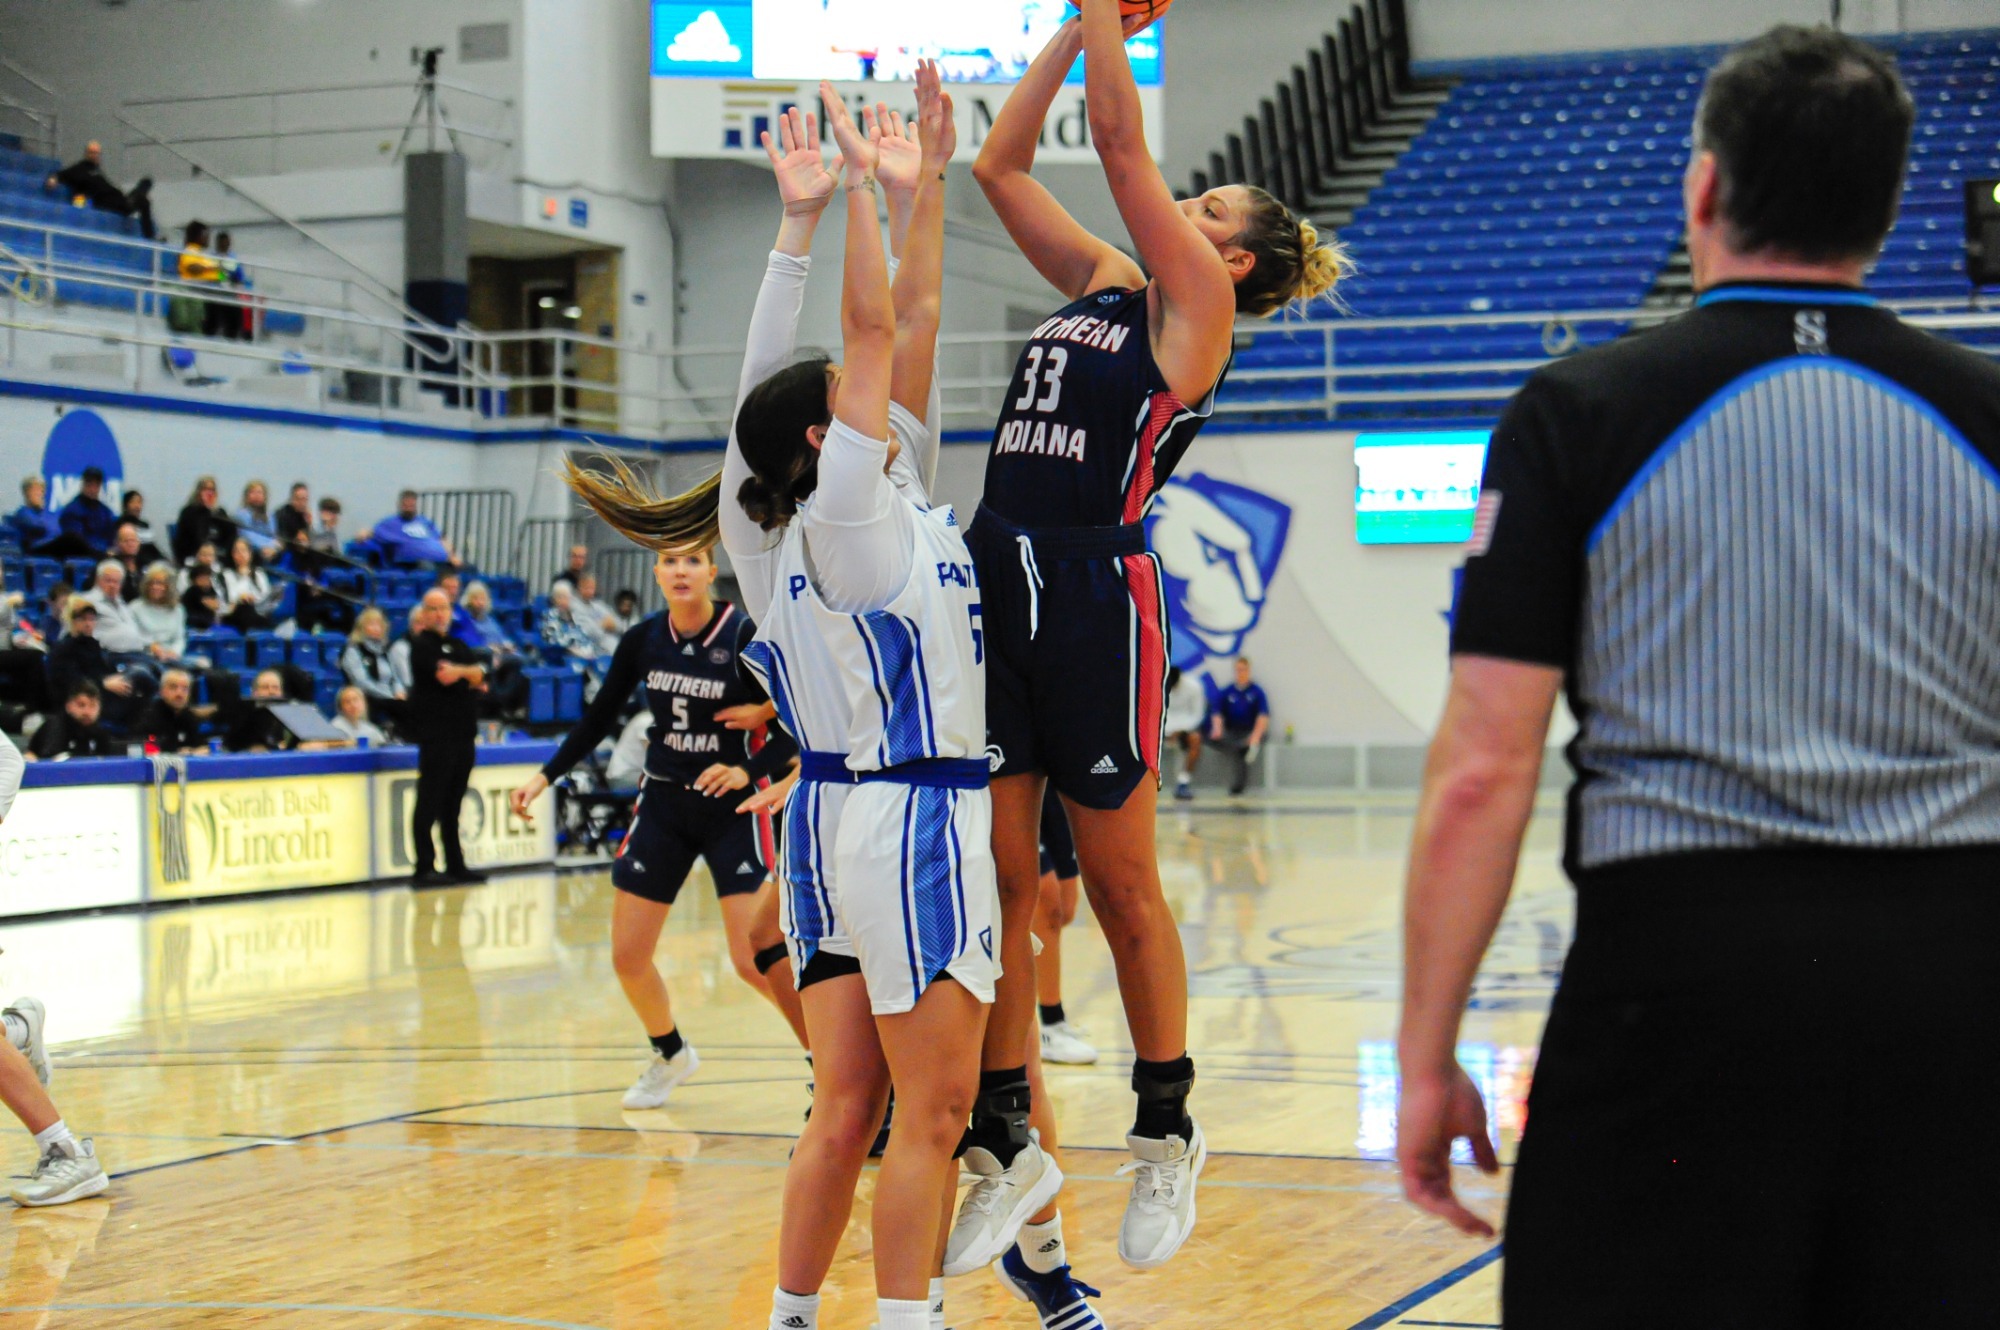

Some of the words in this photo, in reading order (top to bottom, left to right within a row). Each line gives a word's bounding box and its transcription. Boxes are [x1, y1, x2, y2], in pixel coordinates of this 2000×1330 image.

[1015, 345, 1068, 413] 33
[995, 420, 1086, 462] NDIANA
[646, 669, 726, 699] SOUTHERN
[671, 696, 690, 730] 5
[219, 788, 276, 819] Sarah
[282, 784, 331, 816] Bush
[222, 818, 333, 867] Lincoln
